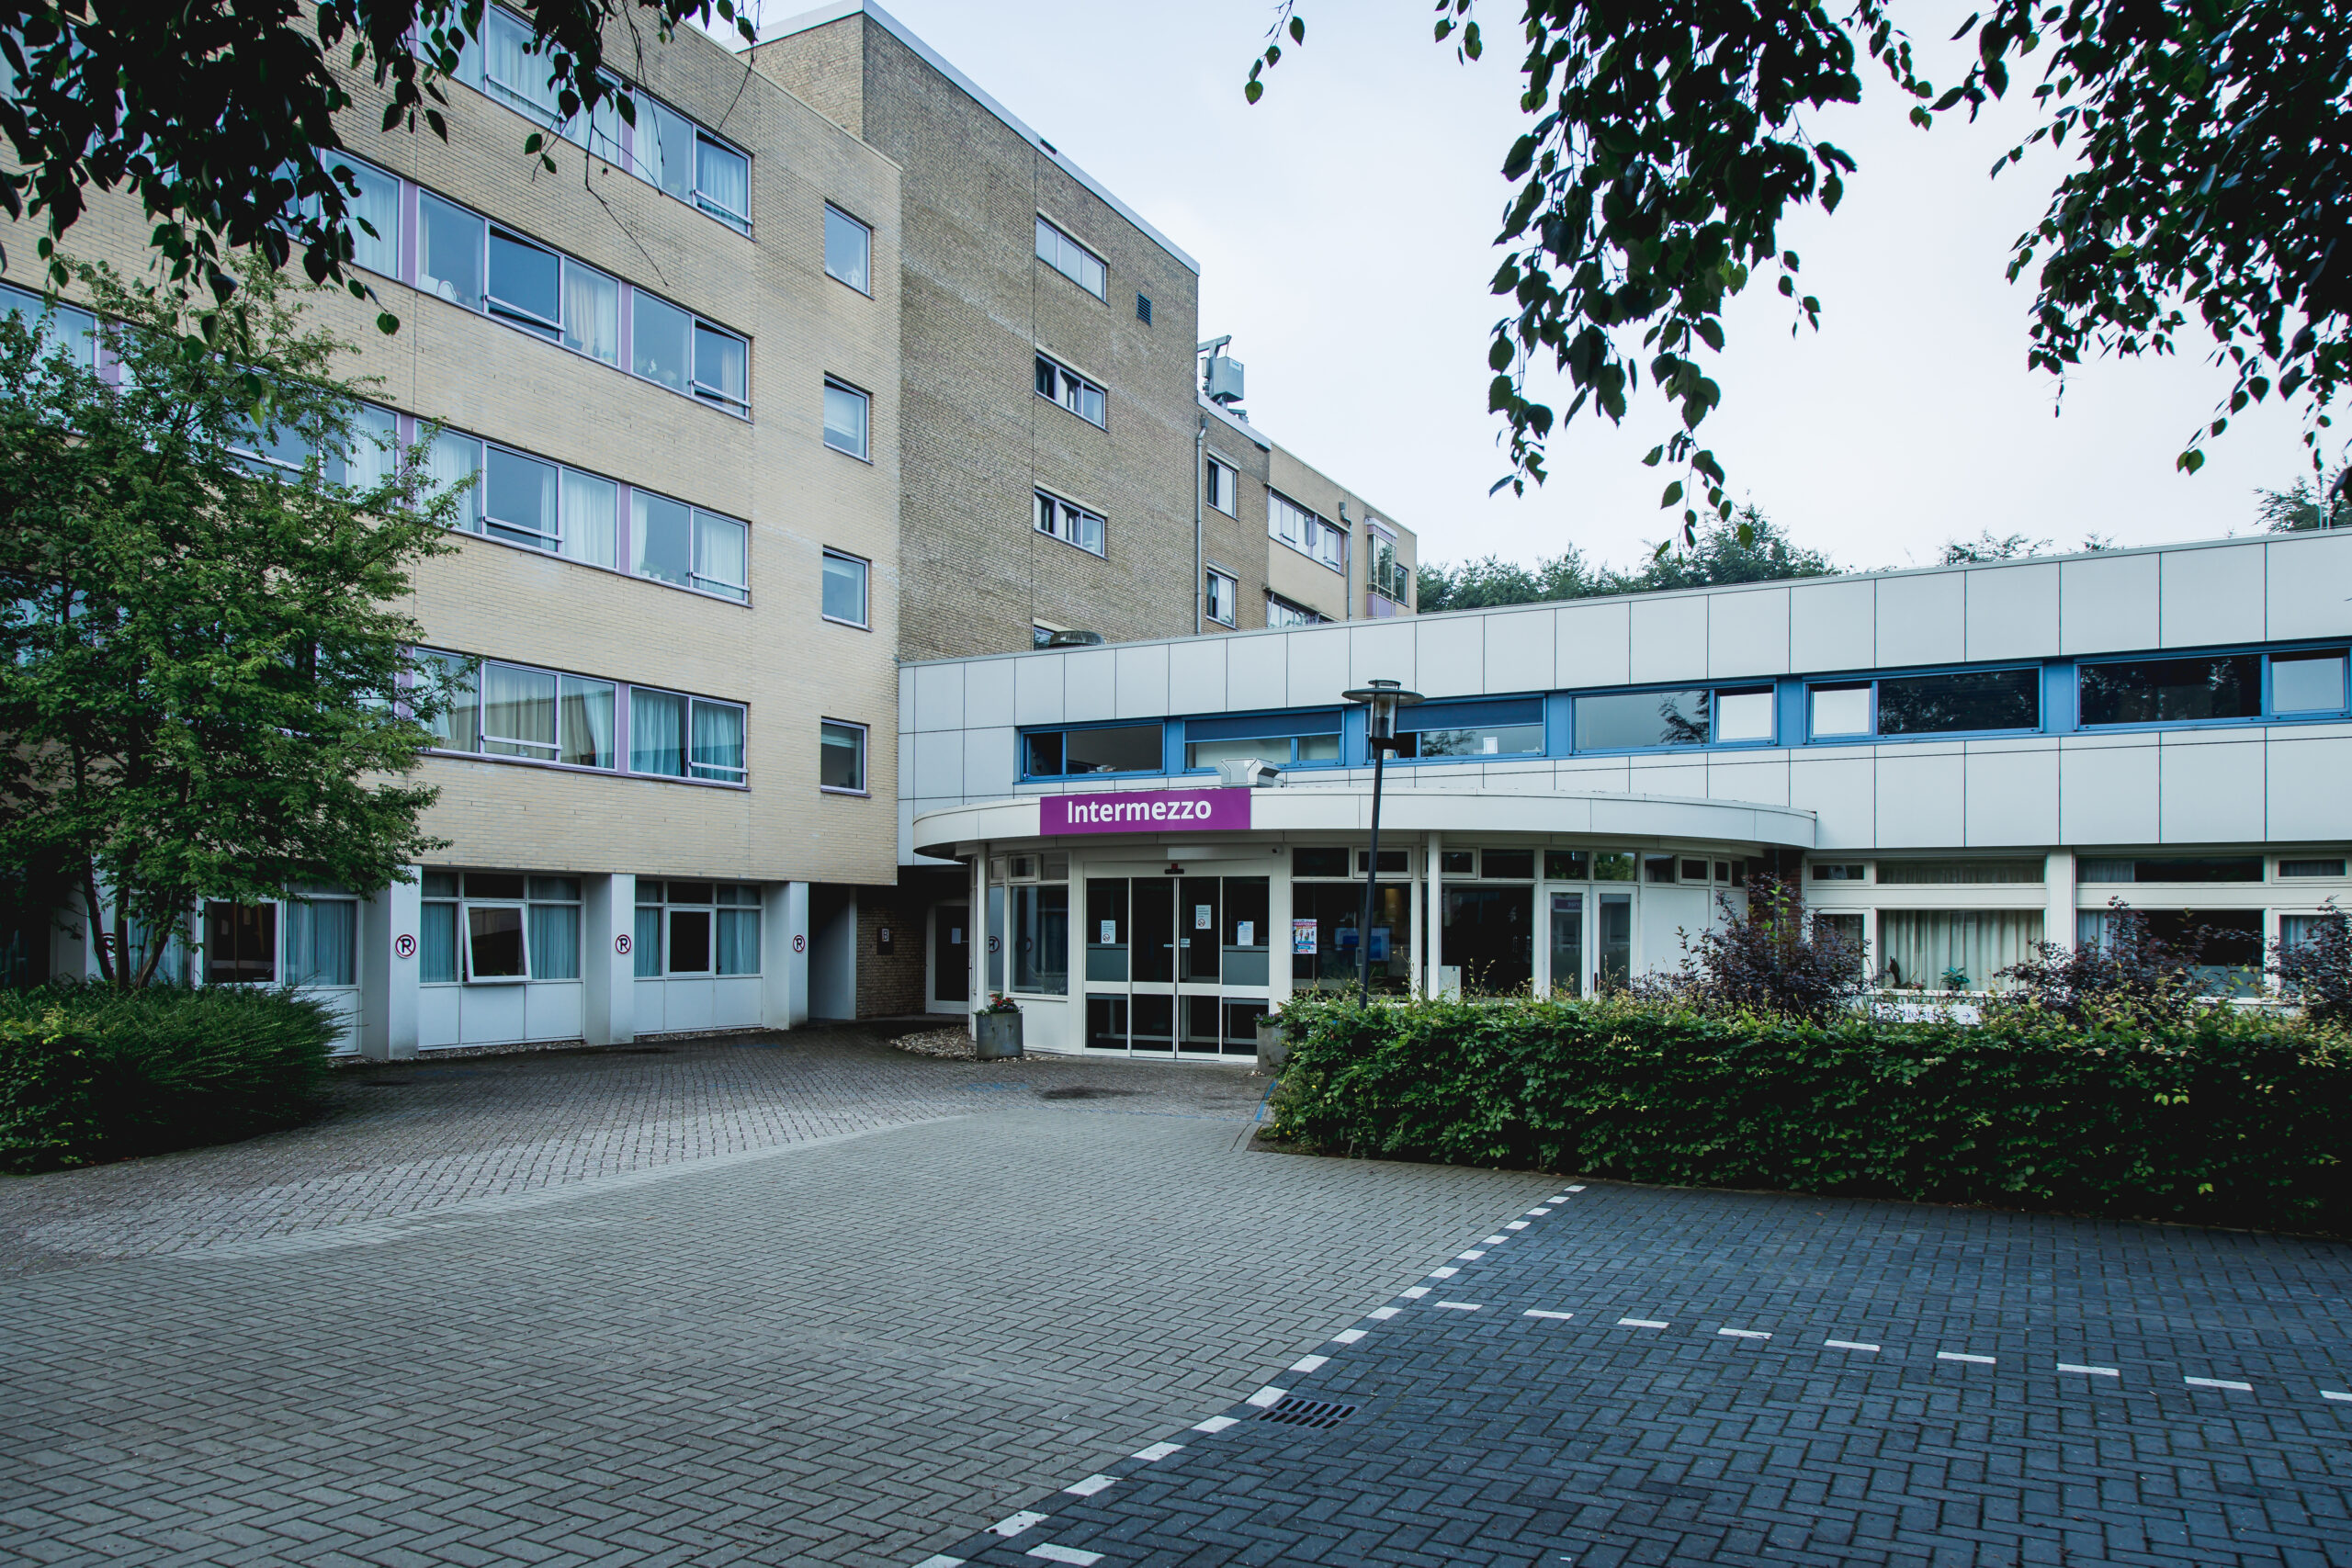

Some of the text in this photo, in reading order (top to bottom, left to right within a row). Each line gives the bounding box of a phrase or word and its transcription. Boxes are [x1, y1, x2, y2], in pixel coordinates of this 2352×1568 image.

[1068, 800, 1212, 824] Intermezzo
[401, 938, 412, 953] P
[620, 938, 628, 951] P
